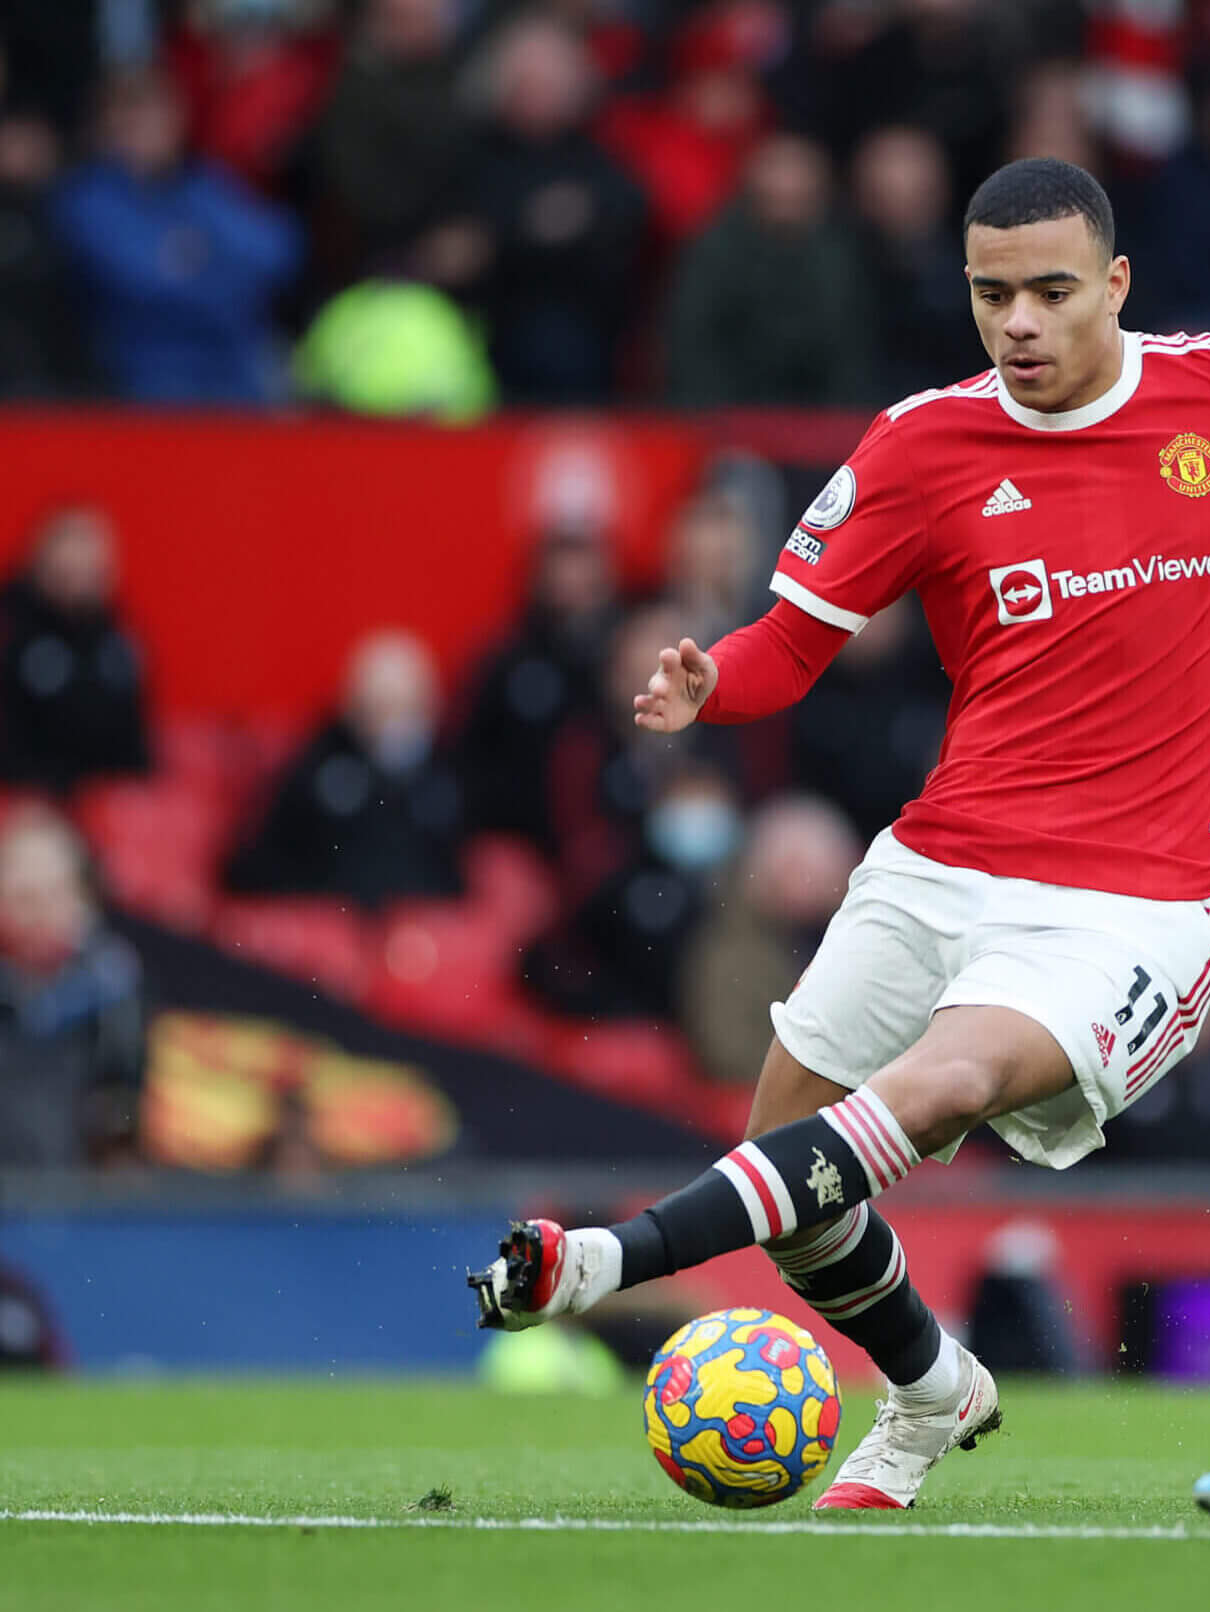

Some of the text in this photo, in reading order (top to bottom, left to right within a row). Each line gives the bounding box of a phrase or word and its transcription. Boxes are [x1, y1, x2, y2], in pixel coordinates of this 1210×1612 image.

[981, 498, 1032, 518] adidas
[1114, 965, 1169, 1057] 11
[1091, 1022, 1110, 1068] adidas
